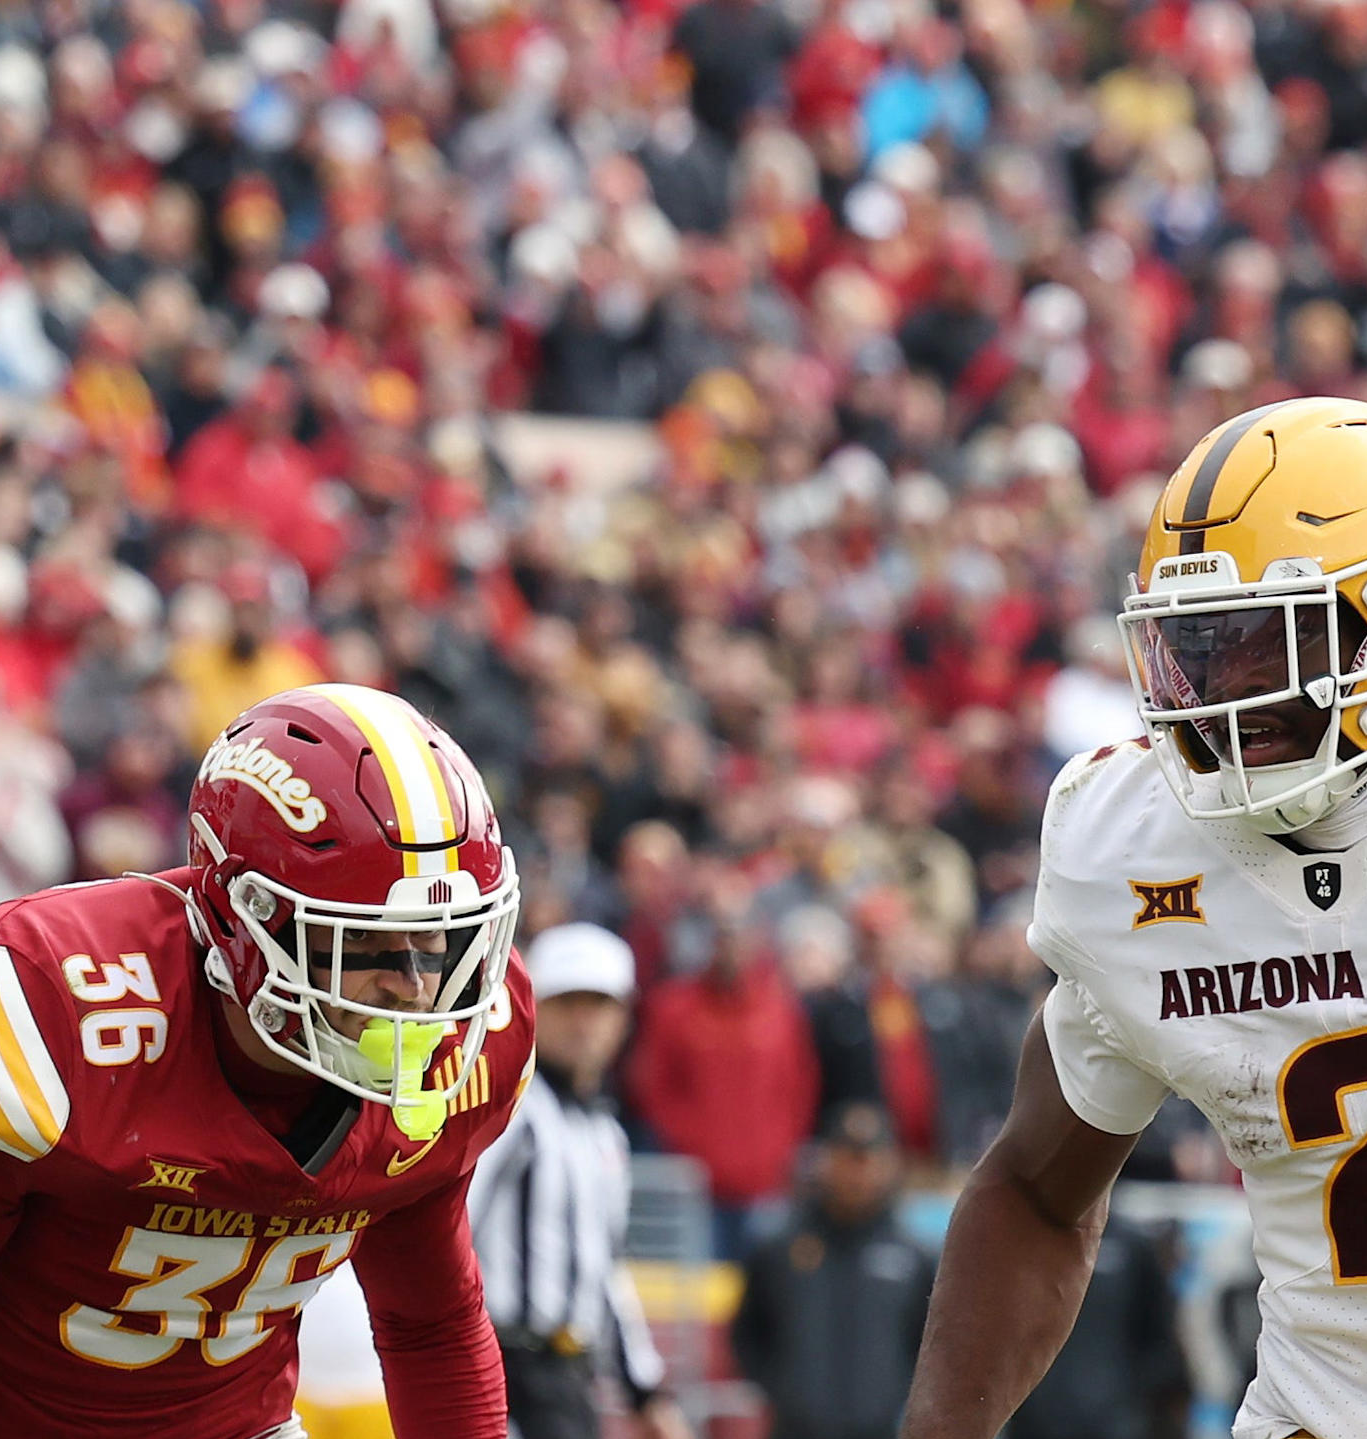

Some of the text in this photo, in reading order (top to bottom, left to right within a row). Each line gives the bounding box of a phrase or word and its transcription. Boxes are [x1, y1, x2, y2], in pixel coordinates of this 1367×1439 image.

[1159, 560, 1218, 579] SUN DEVILS
[1315, 868, 1330, 881] PT
[1317, 885, 1332, 897] 42
[1130, 875, 1205, 927] XII
[1159, 950, 1364, 1020] ARIZONA
[61, 951, 169, 1067] 36
[138, 1159, 208, 1194] XII
[145, 1202, 255, 1237] IOWA
[59, 1226, 358, 1371] 36
